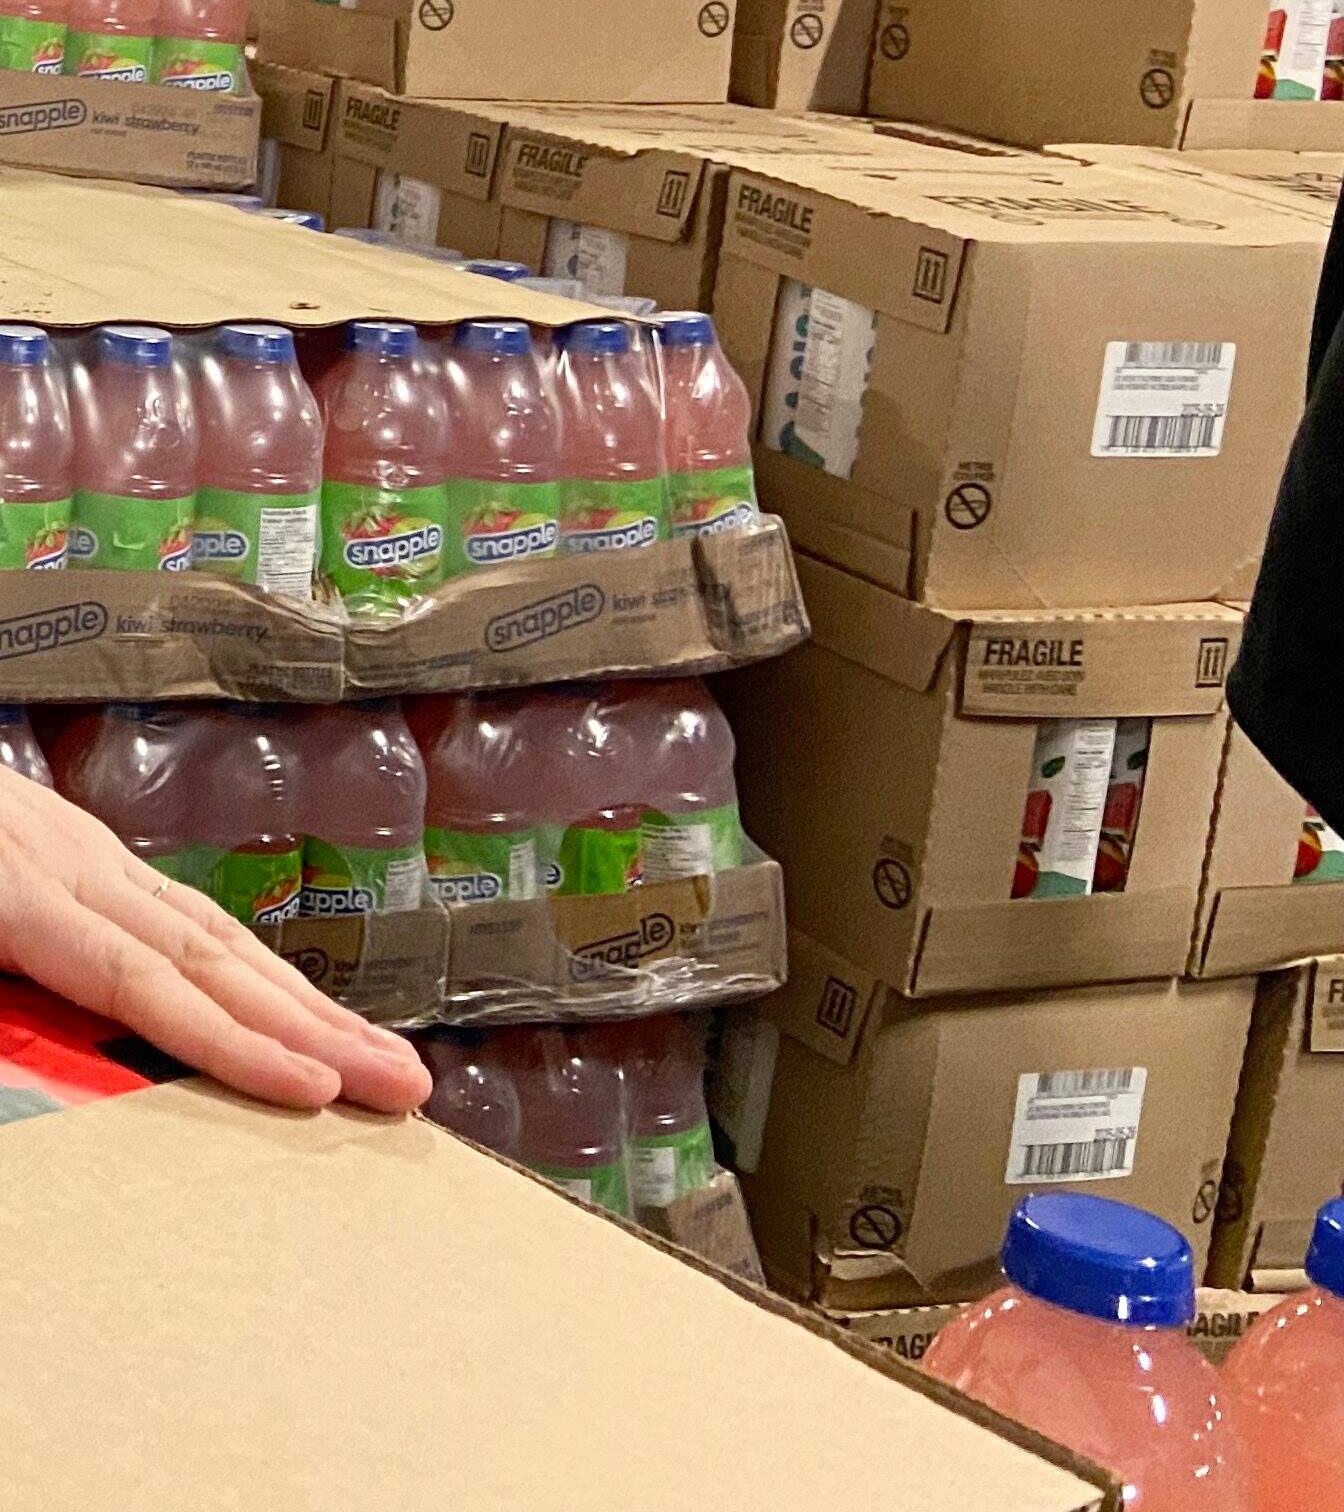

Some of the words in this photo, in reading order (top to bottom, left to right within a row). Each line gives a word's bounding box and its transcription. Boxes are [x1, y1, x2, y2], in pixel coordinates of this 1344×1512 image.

[92, 111, 121, 125] kiwi
[124, 114, 201, 135] strawberry
[346, 97, 401, 131] FRAGILE
[516, 142, 589, 178] FRAGILE
[736, 183, 814, 234] FRAGILE
[351, 526, 440, 562] snapple
[470, 522, 556, 558] snapple
[115, 613, 153, 634] kiwi
[159, 617, 268, 643] strawberry
[493, 588, 598, 644] snapple
[983, 639, 1084, 667] FRAGILE
